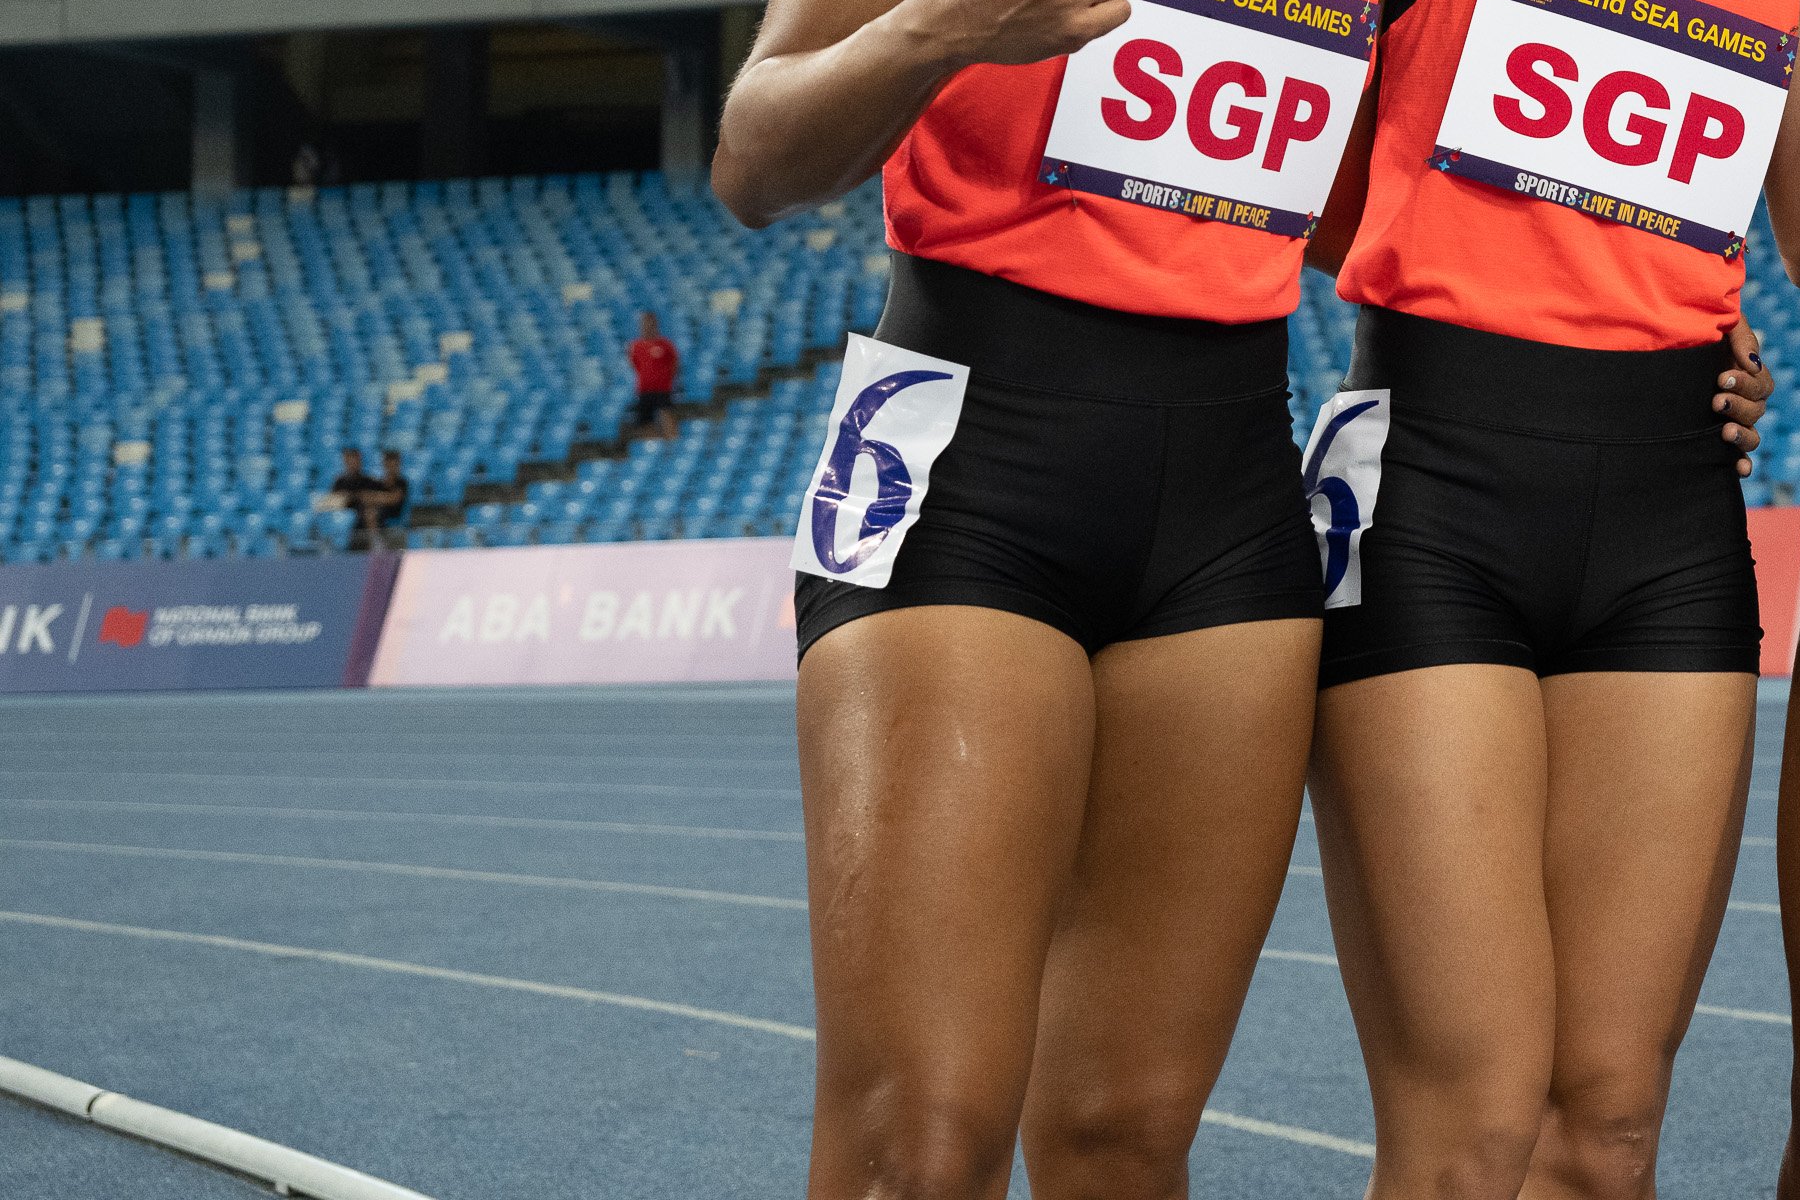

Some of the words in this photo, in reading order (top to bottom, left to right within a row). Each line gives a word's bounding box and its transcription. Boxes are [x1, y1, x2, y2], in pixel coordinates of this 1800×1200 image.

[1631, 0, 1679, 33] SEA
[1686, 17, 1767, 63] GAMES
[1101, 38, 1331, 173] SGP
[1493, 42, 1746, 185] SGP
[1215, 201, 1232, 221] IN
[1232, 204, 1271, 228] PEACE
[1616, 202, 1636, 223] IN
[1636, 209, 1682, 238] PEACE
[811, 369, 954, 575] 6
[439, 596, 551, 643] ABA
[578, 587, 740, 641] BANK
